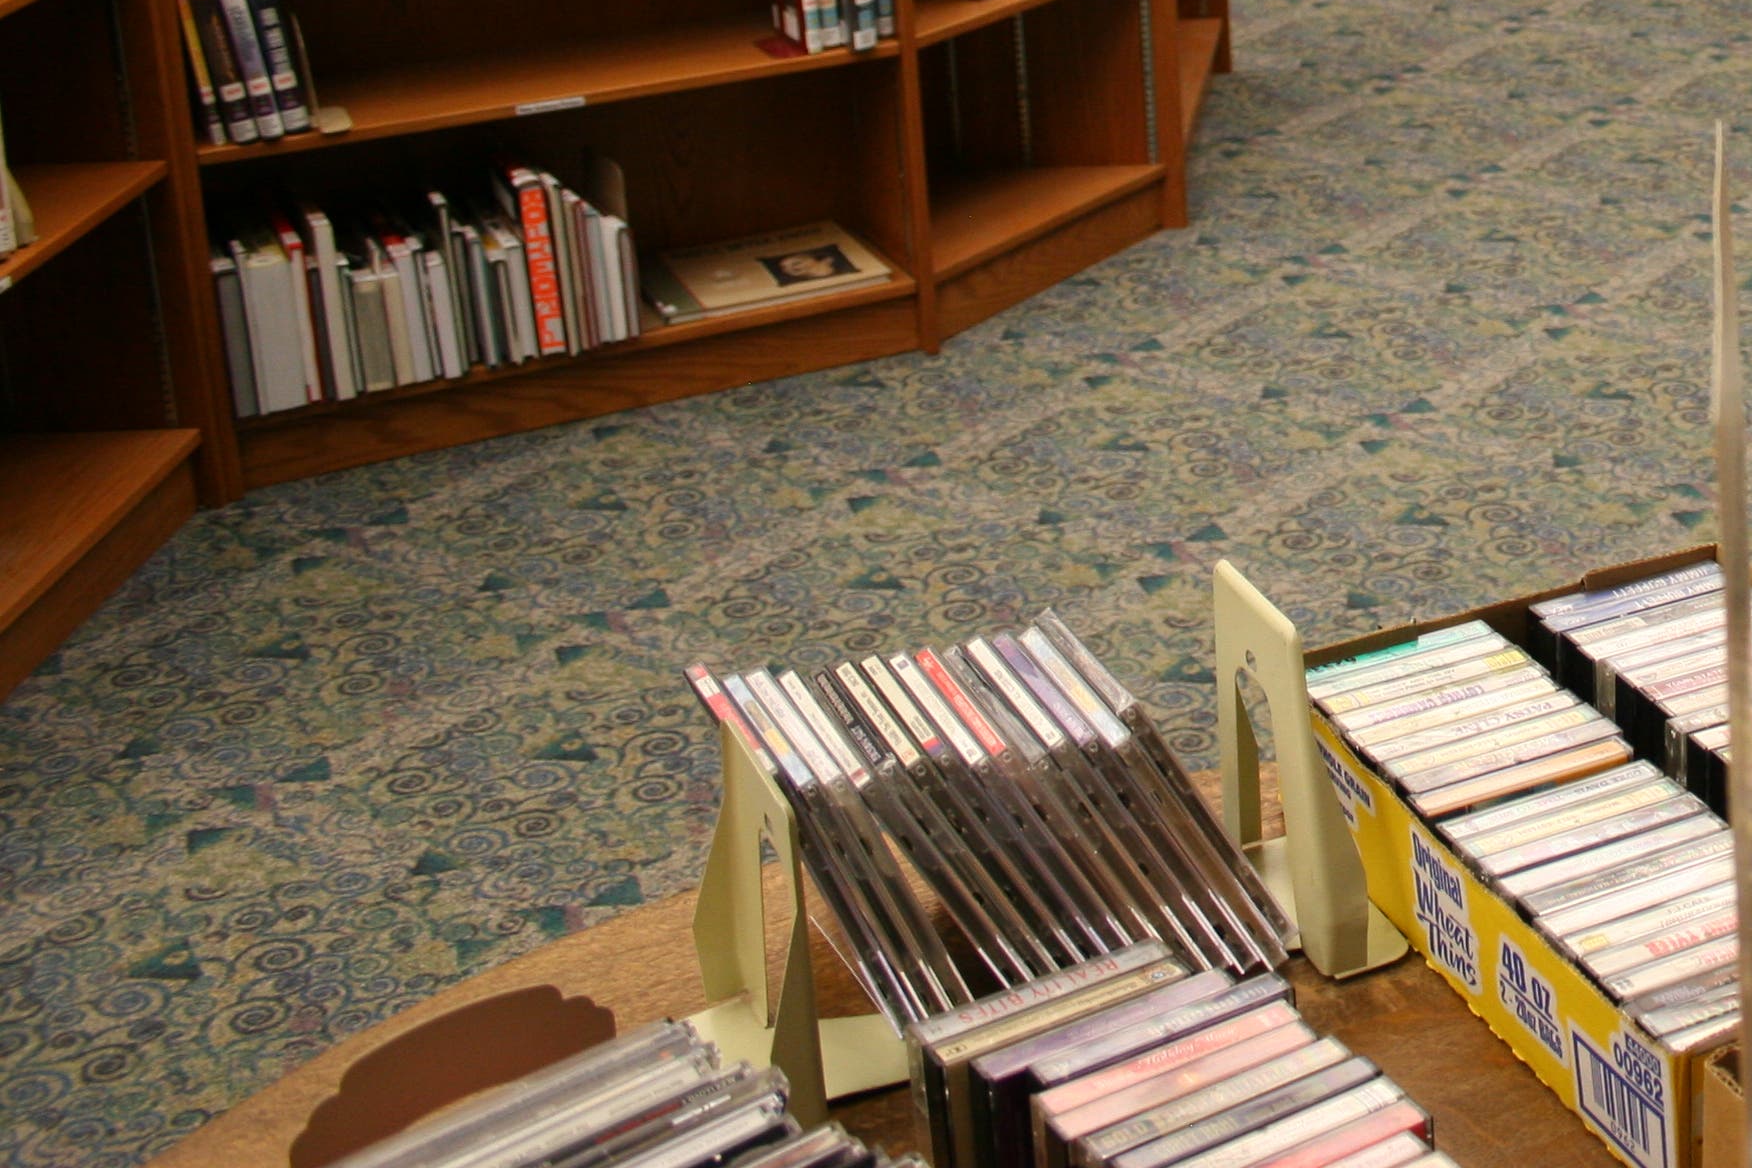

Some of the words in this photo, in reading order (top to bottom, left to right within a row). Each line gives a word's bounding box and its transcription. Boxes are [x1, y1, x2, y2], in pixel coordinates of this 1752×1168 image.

[1611, 572, 1668, 604] BUFFETT
[1666, 561, 1708, 588] JIMMY
[1449, 709, 1502, 742] CLINE
[1502, 694, 1553, 726] PATSY
[1343, 770, 1371, 807] GRAIN
[1412, 832, 1463, 909] Original
[1416, 868, 1475, 961] Wheat
[1418, 911, 1478, 987] Thins
[1502, 941, 1527, 993] 40
[1028, 953, 1118, 1002] REALITY
[957, 989, 1024, 1028] BITES
[1613, 1042, 1665, 1105] 00962
